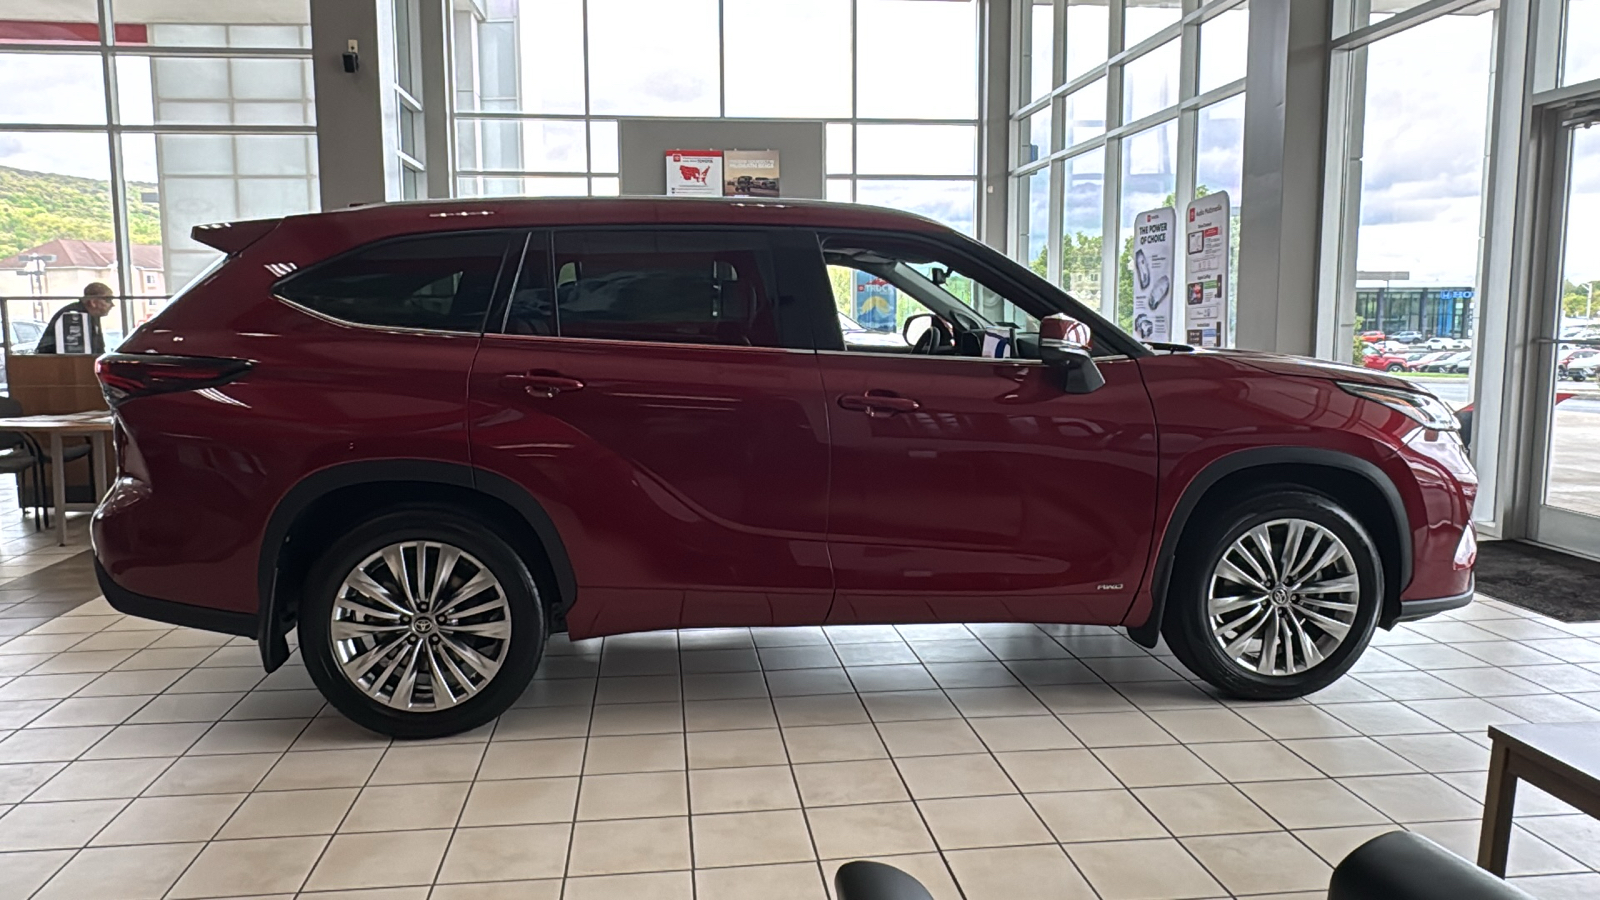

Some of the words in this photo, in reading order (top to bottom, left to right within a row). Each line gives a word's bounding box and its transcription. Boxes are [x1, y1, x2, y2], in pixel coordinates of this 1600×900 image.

[1139, 226, 1148, 234] THE
[1149, 222, 1168, 233] POWER
[1140, 236, 1147, 245] OF
[1147, 233, 1166, 243] CHOICE
[865, 284, 890, 292] TRUC
